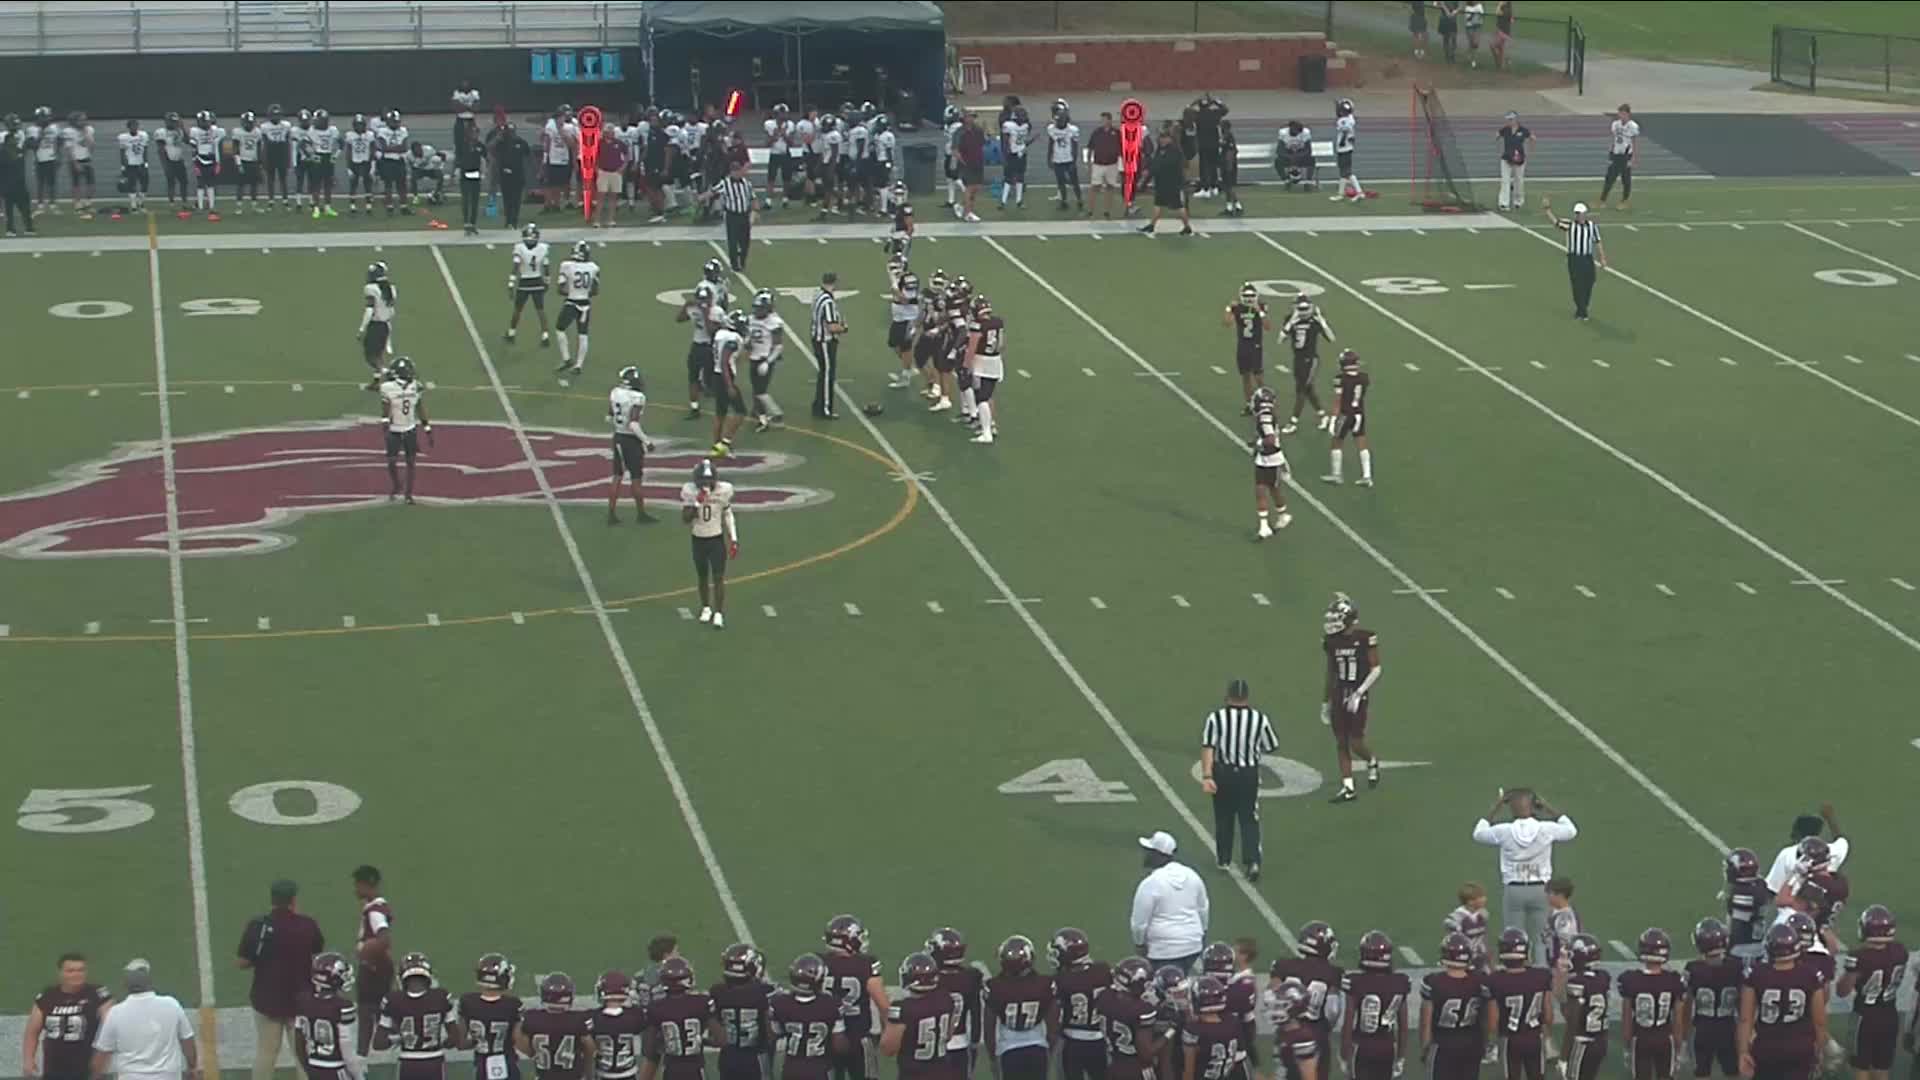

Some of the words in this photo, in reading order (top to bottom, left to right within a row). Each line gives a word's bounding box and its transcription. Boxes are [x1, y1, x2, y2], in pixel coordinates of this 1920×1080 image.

[530, 255, 537, 272] 4
[573, 271, 592, 289] 20
[1243, 319, 1253, 338] 2
[702, 505, 712, 522] 0
[1336, 657, 1357, 681] 11
[1505, 992, 1543, 1031] 74
[399, 1014, 441, 1050] 45
[784, 1021, 829, 1057] 72
[532, 1034, 576, 1070] 54
